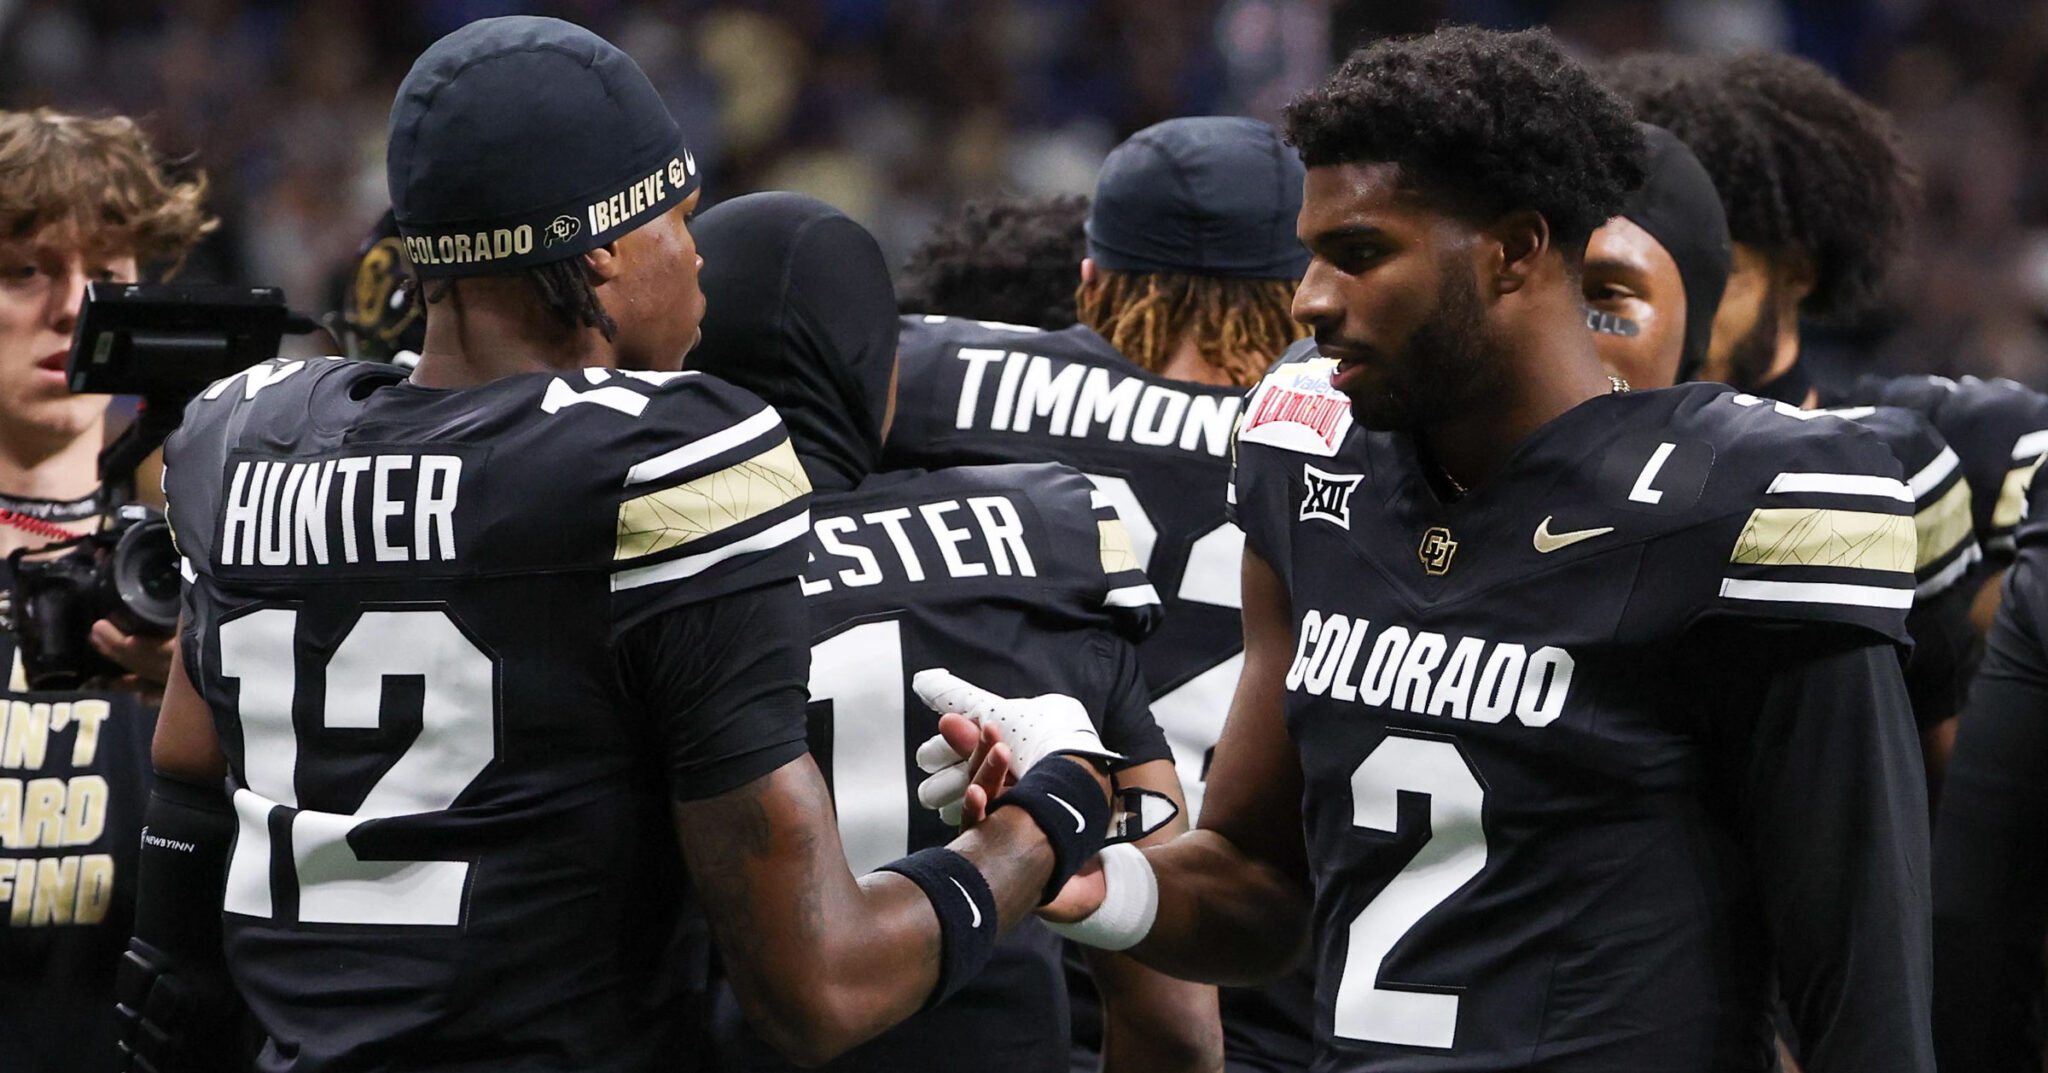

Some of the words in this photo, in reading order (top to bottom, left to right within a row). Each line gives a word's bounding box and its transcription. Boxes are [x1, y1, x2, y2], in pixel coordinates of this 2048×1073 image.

[405, 224, 533, 264] COLORADO
[220, 454, 463, 566] HUNTER
[1285, 609, 1576, 728] COLORADO
[219, 608, 495, 926] 12
[1333, 735, 1489, 1049] 2
